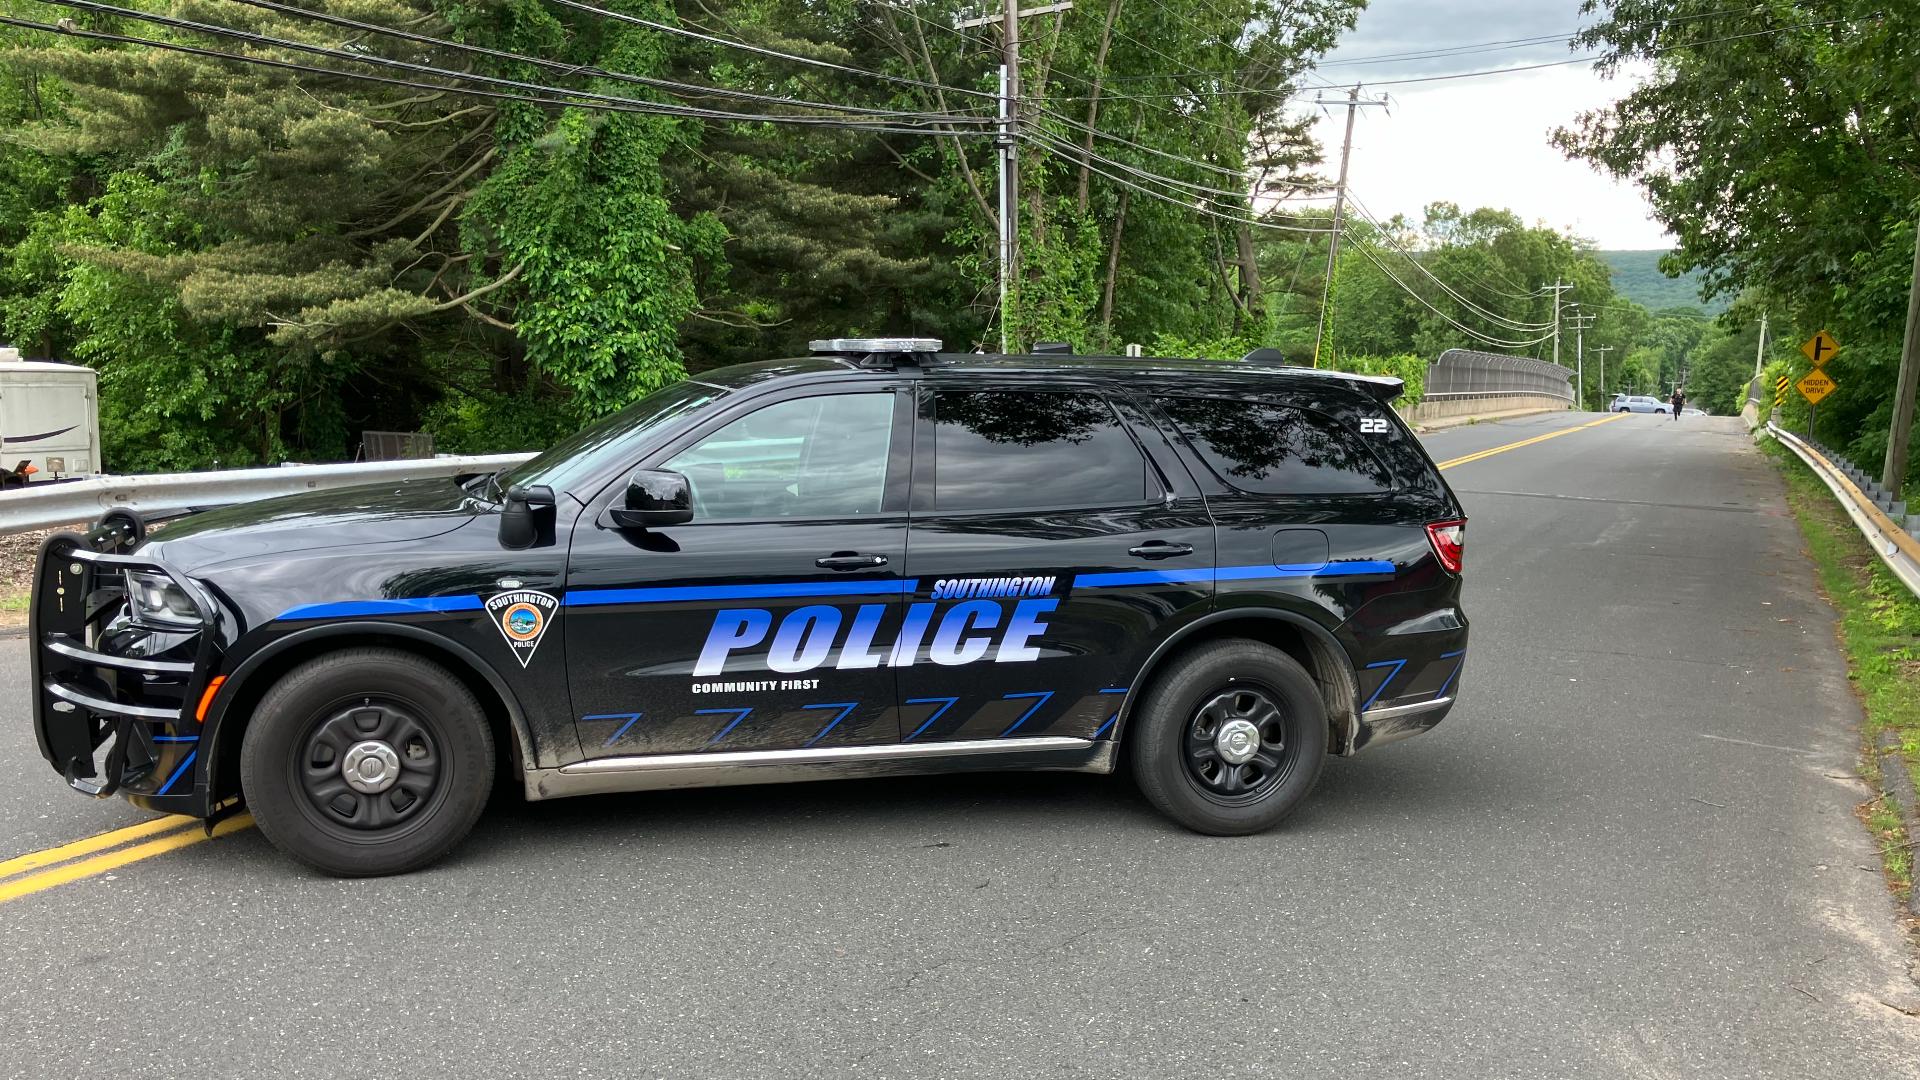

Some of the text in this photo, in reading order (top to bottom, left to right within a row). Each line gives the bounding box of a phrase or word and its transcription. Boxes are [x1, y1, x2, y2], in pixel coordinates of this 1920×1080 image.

[1360, 418, 1387, 433] 22
[931, 576, 1057, 600] SOUTHINGTON
[489, 593, 554, 611] SOUTHINGTON
[513, 640, 535, 648] POLICE
[693, 598, 1059, 678] POLICE
[691, 678, 820, 695] COMMUNITY FIRST
